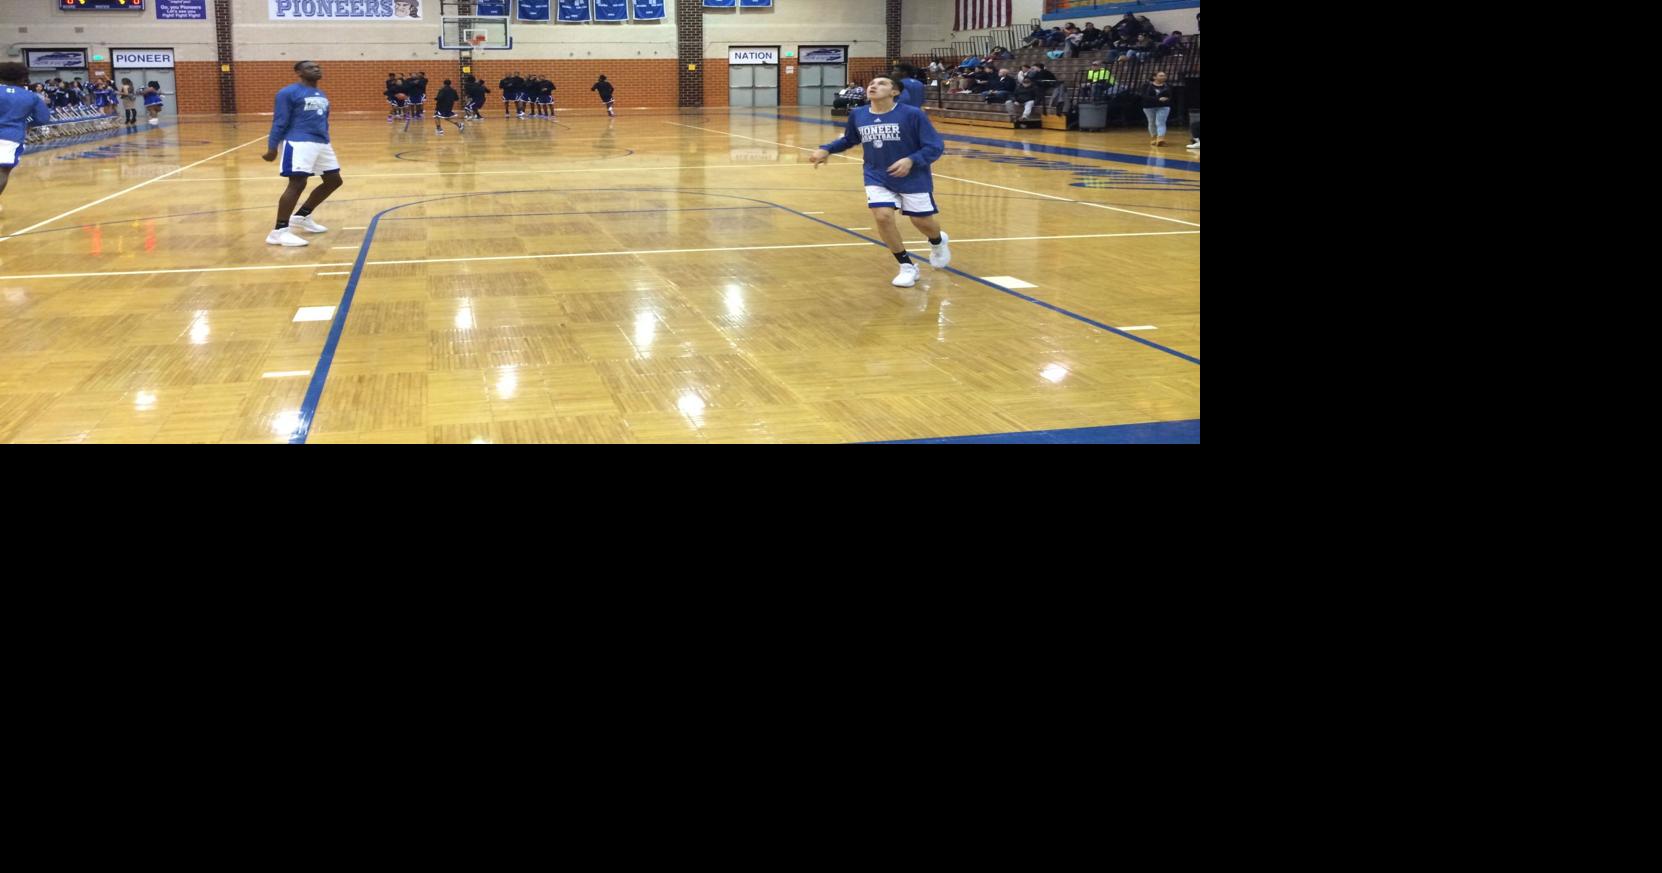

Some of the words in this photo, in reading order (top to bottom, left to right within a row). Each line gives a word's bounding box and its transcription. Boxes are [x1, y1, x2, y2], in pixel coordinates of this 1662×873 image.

[276, 0, 393, 17] PIONEERS
[116, 54, 170, 63] PIONEER
[734, 51, 772, 60] NATION
